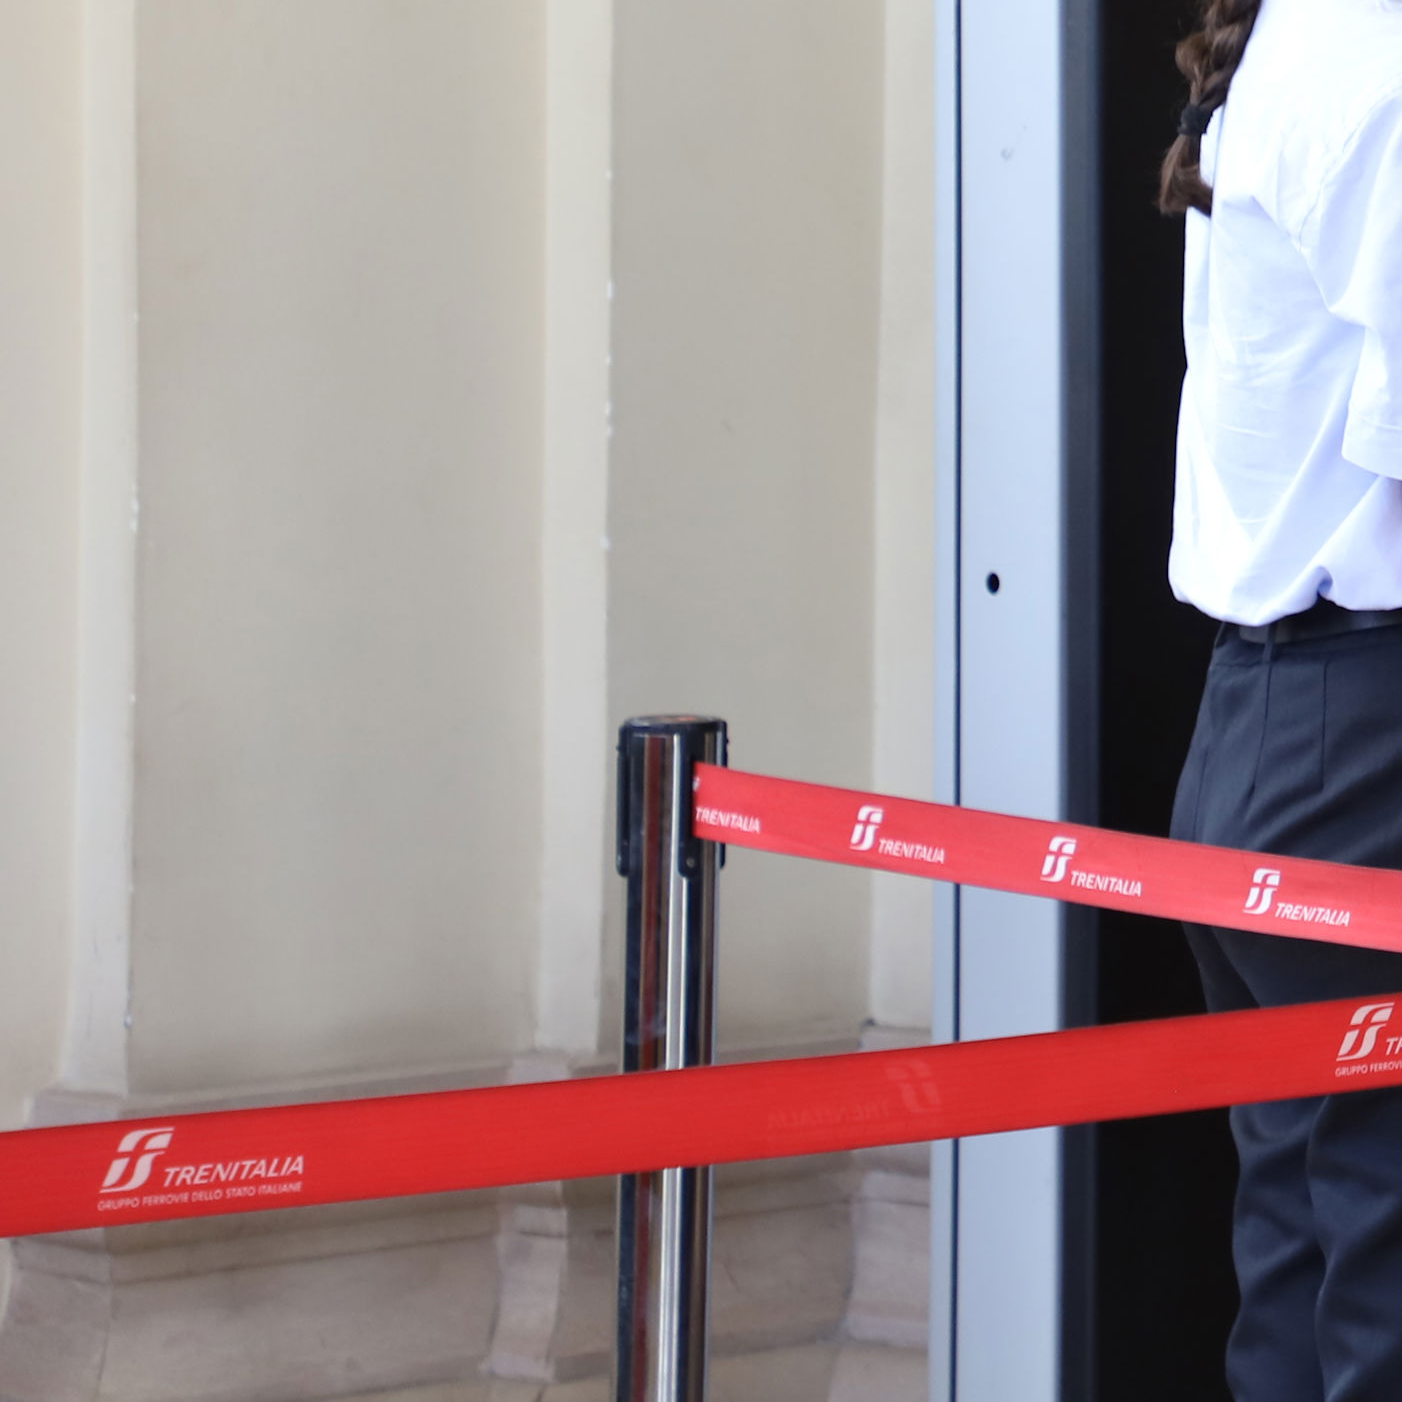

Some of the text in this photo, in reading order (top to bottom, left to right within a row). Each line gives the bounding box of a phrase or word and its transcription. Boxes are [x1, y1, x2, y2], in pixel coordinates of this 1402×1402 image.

[694, 805, 761, 834] TRENITALIA
[878, 837, 945, 864] TRENITALIA
[1070, 870, 1142, 897] TRENITALIA
[1274, 901, 1351, 927] TRENITALIA
[1335, 1064, 1369, 1077] GRUPPO
[164, 1154, 304, 1188] TRENITALIA
[97, 1180, 303, 1212] GRUPPO FERROVIE DELLO STATO ITALIANE
